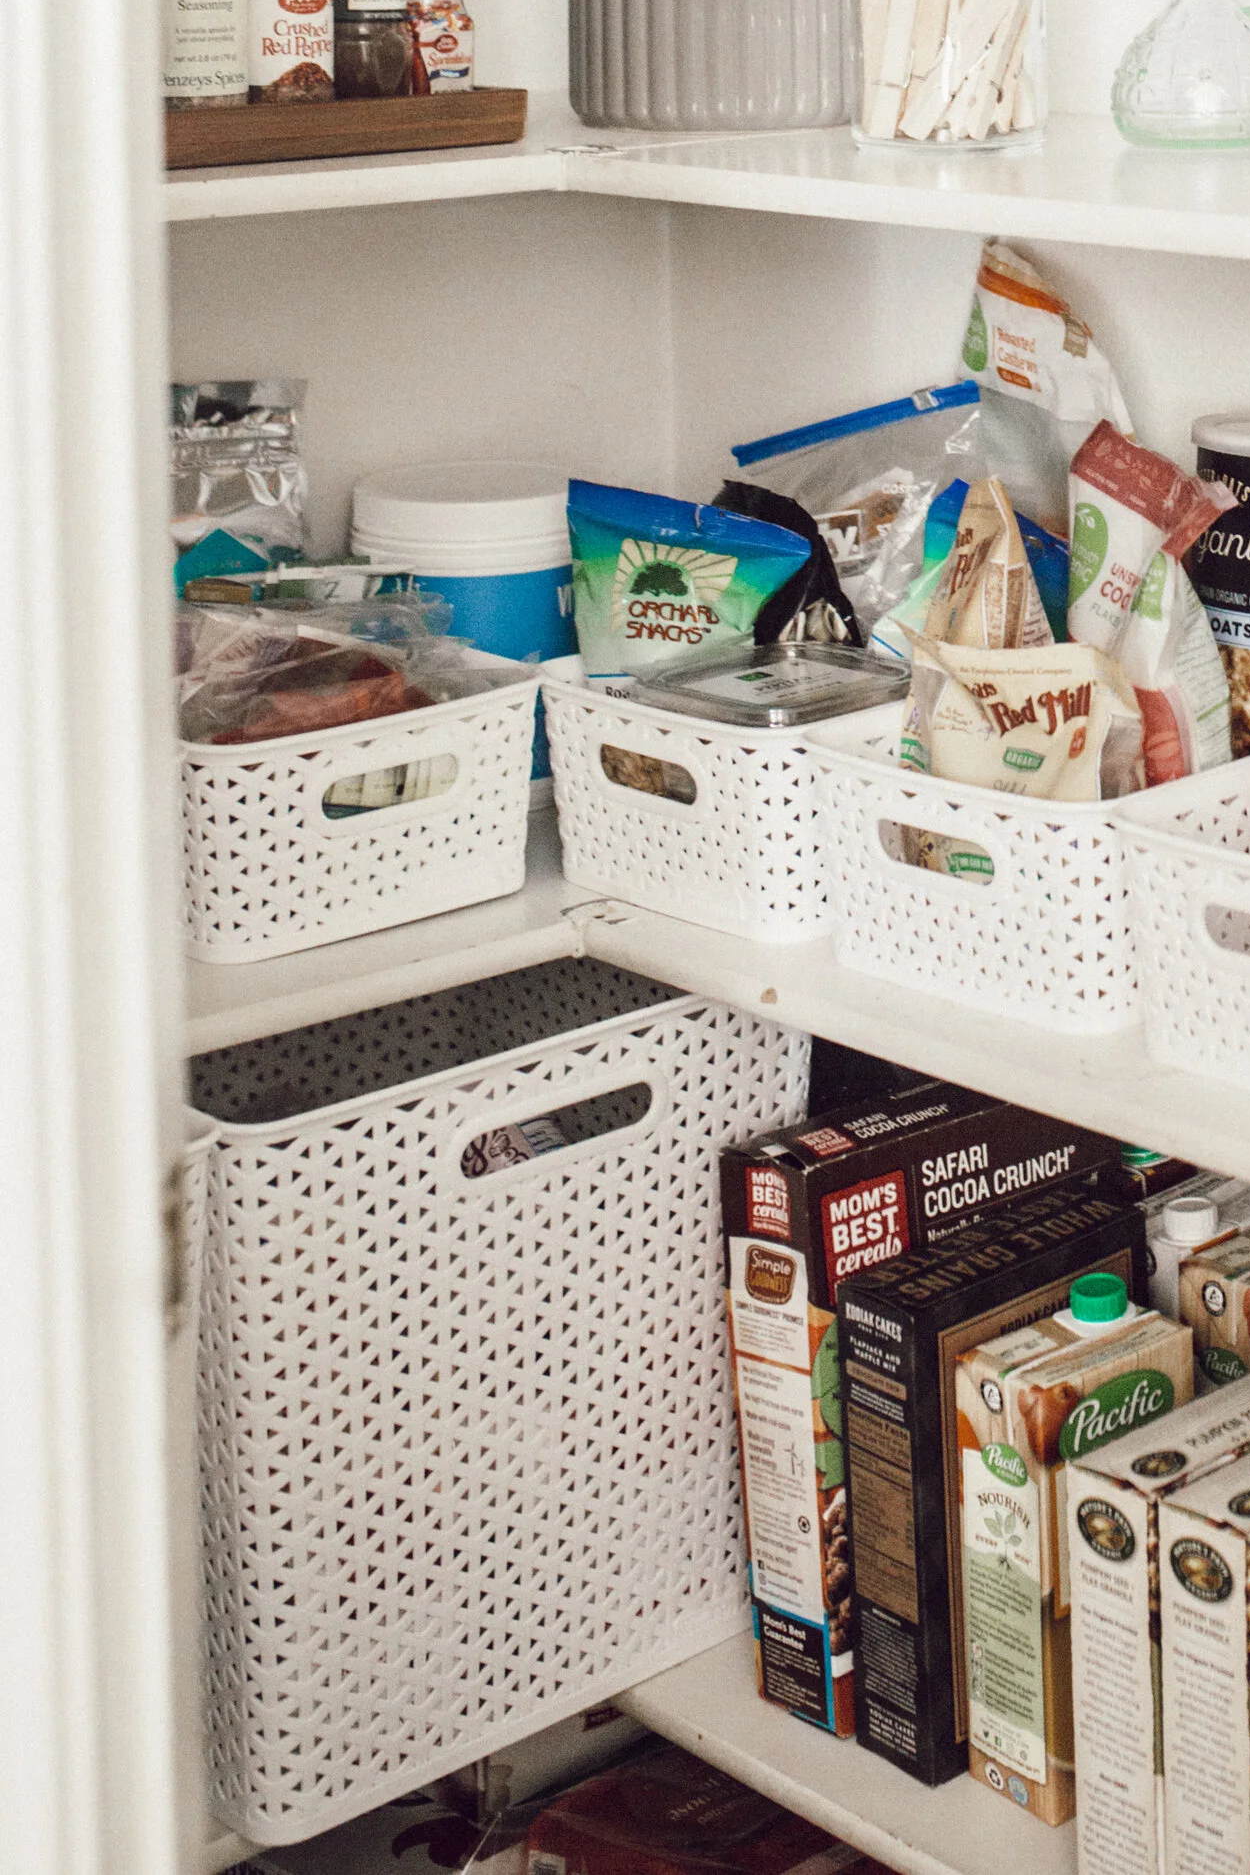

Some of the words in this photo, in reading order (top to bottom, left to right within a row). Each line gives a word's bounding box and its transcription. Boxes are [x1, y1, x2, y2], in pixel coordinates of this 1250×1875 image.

[177, 0, 234, 12] Seasoning
[273, 19, 329, 39] Crushed
[261, 37, 292, 56] Red
[294, 36, 333, 59] Peppe
[162, 73, 213, 91] enzeys
[1215, 588, 1249, 608] ORGANIC
[627, 600, 721, 626] ORCHARD
[625, 620, 704, 645] SNACKS
[967, 682, 998, 700] ob's
[988, 696, 1039, 738] Red
[1037, 681, 1092, 736] Mill
[845, 1111, 889, 1131] SAFARI
[854, 1121, 898, 1140] COCOA
[897, 1104, 945, 1128] CRUNCH
[921, 1142, 989, 1186] SAFARI
[923, 1175, 991, 1218] COCOA
[993, 1146, 1070, 1195] CRUNCH
[752, 1186, 788, 1209] BEST
[829, 1182, 898, 1224] MOM'S
[753, 1204, 789, 1225] cereals
[831, 1205, 899, 1255] BEST
[751, 1249, 793, 1275] Simple
[836, 1234, 903, 1276] cereals
[845, 1302, 876, 1327] KODIAK
[875, 1313, 902, 1343] CAKES
[850, 1336, 883, 1358] FLAPJACK
[885, 1352, 901, 1366] AND
[854, 1347, 881, 1367] WAFFLE
[882, 1361, 897, 1374] MIX
[1205, 1350, 1245, 1378] Pacific
[1069, 1379, 1165, 1452] Pacific
[985, 1444, 1026, 1479] Pacific
[977, 1491, 1031, 1530] NOURISH
